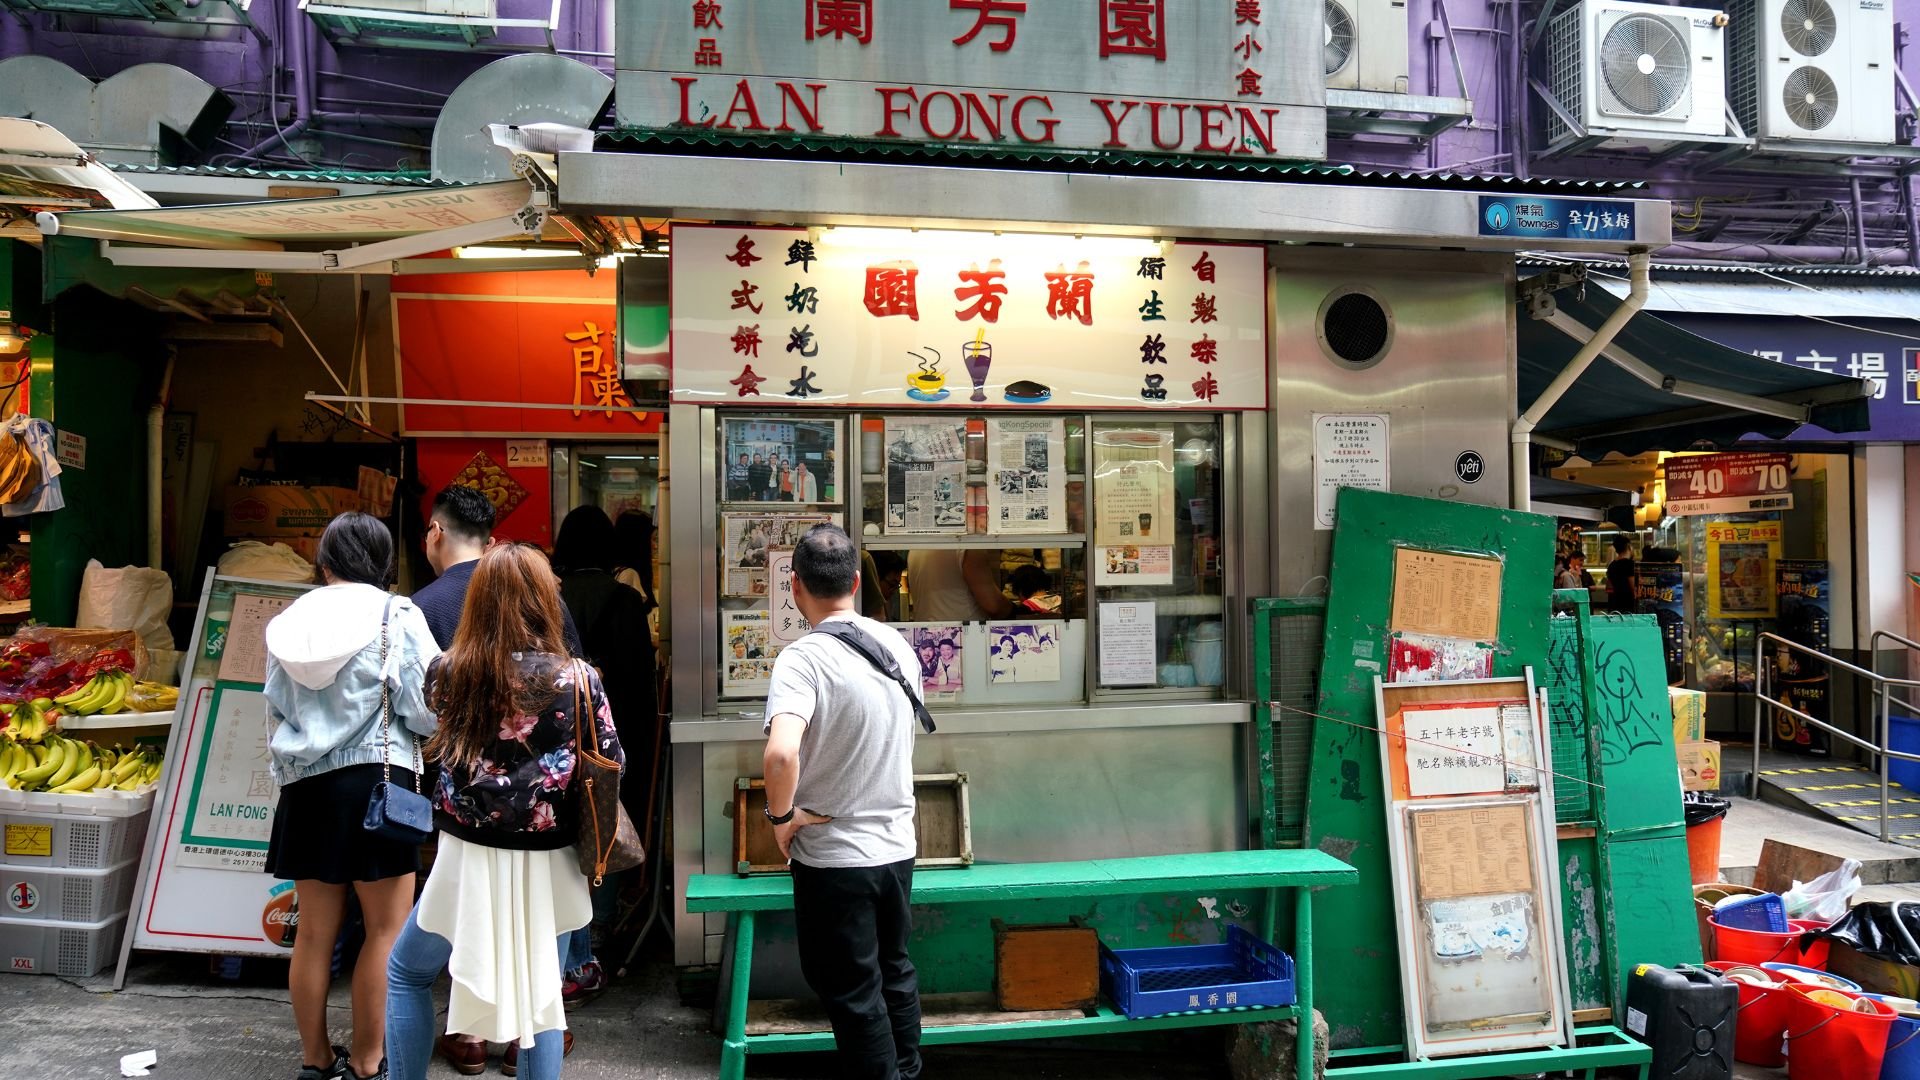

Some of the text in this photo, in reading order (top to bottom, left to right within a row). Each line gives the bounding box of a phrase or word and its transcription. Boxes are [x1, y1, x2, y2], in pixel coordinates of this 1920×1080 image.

[671, 77, 1280, 155] LAN FONG YUEN
[1516, 218, 1559, 230] Towngas
[1568, 210, 1630, 232] 全力支持
[509, 446, 519, 462] 2
[1419, 724, 1495, 741] 五十年老字號
[210, 802, 268, 820] LAN FONG
[14, 959, 32, 969] XXL
[1189, 991, 1237, 1007] 鳳香園
